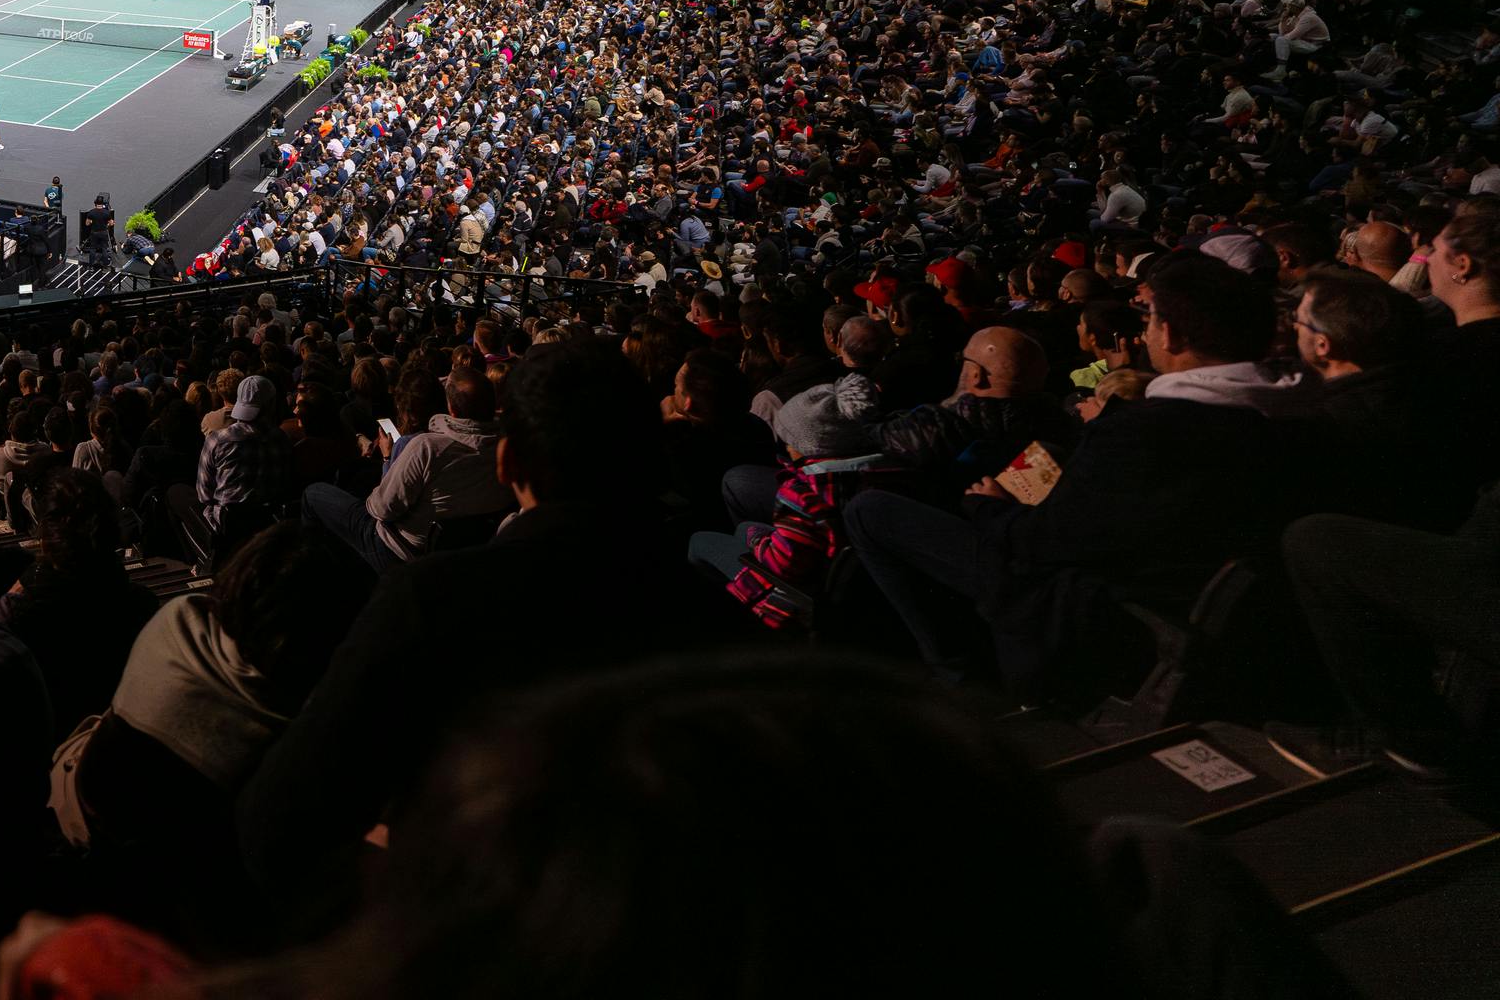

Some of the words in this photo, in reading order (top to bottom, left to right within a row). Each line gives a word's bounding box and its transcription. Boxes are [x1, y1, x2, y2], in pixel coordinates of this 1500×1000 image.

[37, 27, 63, 38] ATP
[64, 30, 94, 42] TOUR
[184, 34, 209, 43] Emirates
